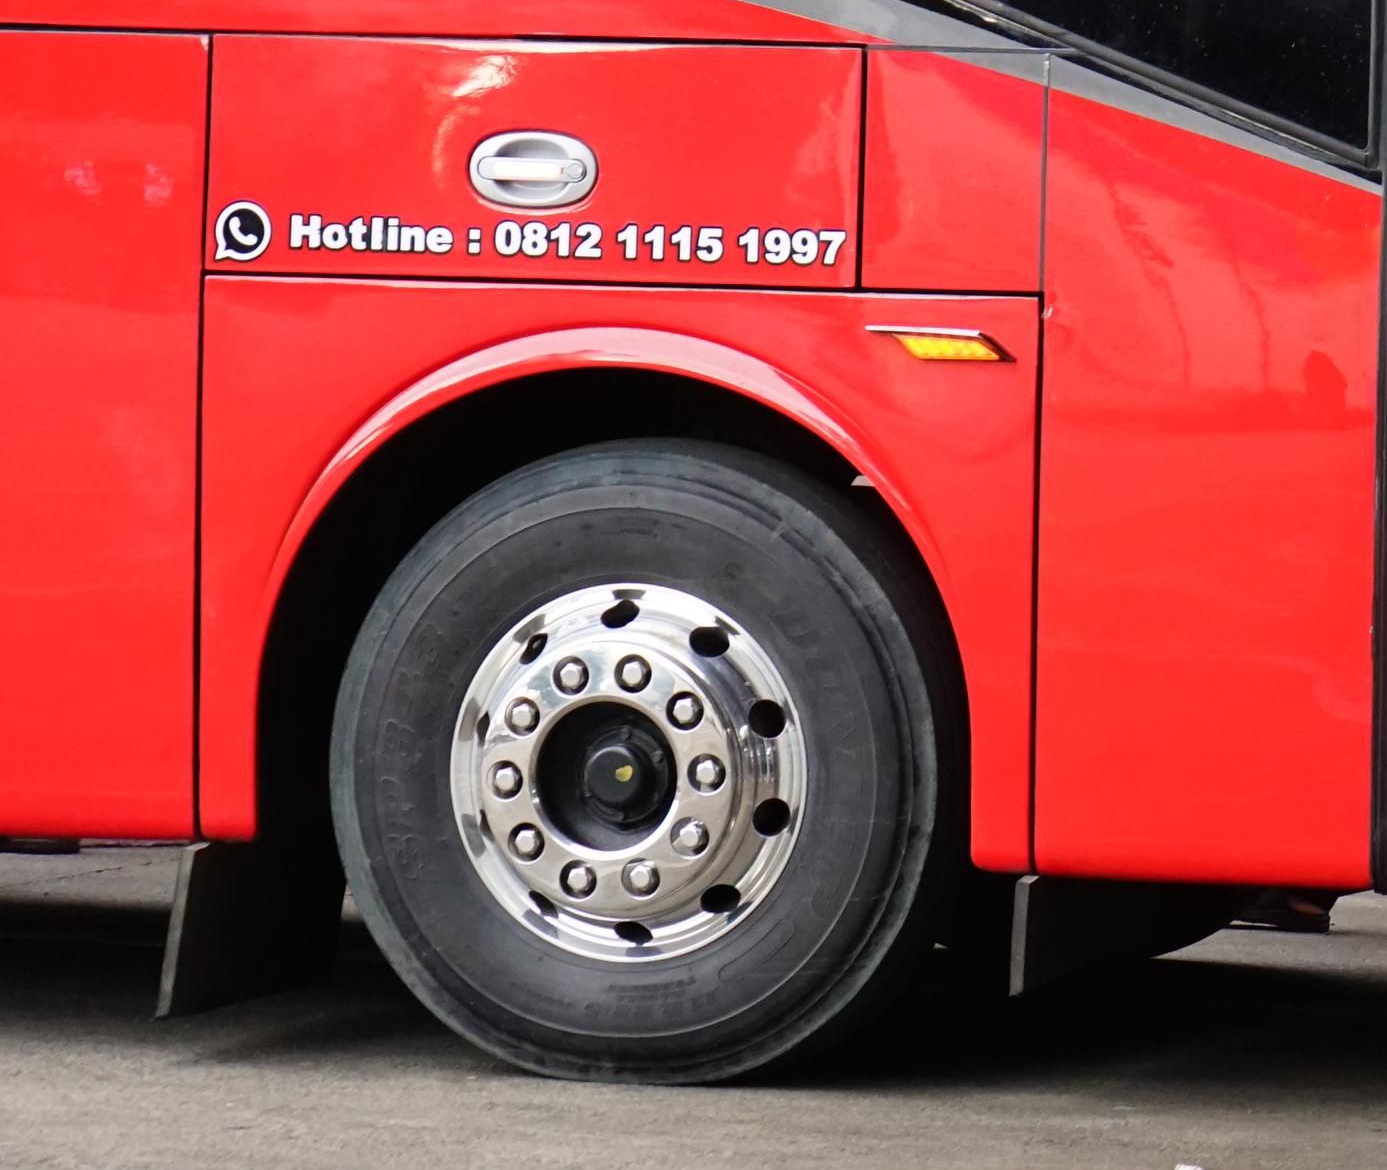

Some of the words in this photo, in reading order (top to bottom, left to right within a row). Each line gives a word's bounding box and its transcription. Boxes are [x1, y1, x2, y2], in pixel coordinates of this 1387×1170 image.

[289, 214, 454, 254] Hotline
[494, 220, 602, 257] 0812
[617, 224, 724, 262] 1115
[738, 228, 846, 265] 1997
